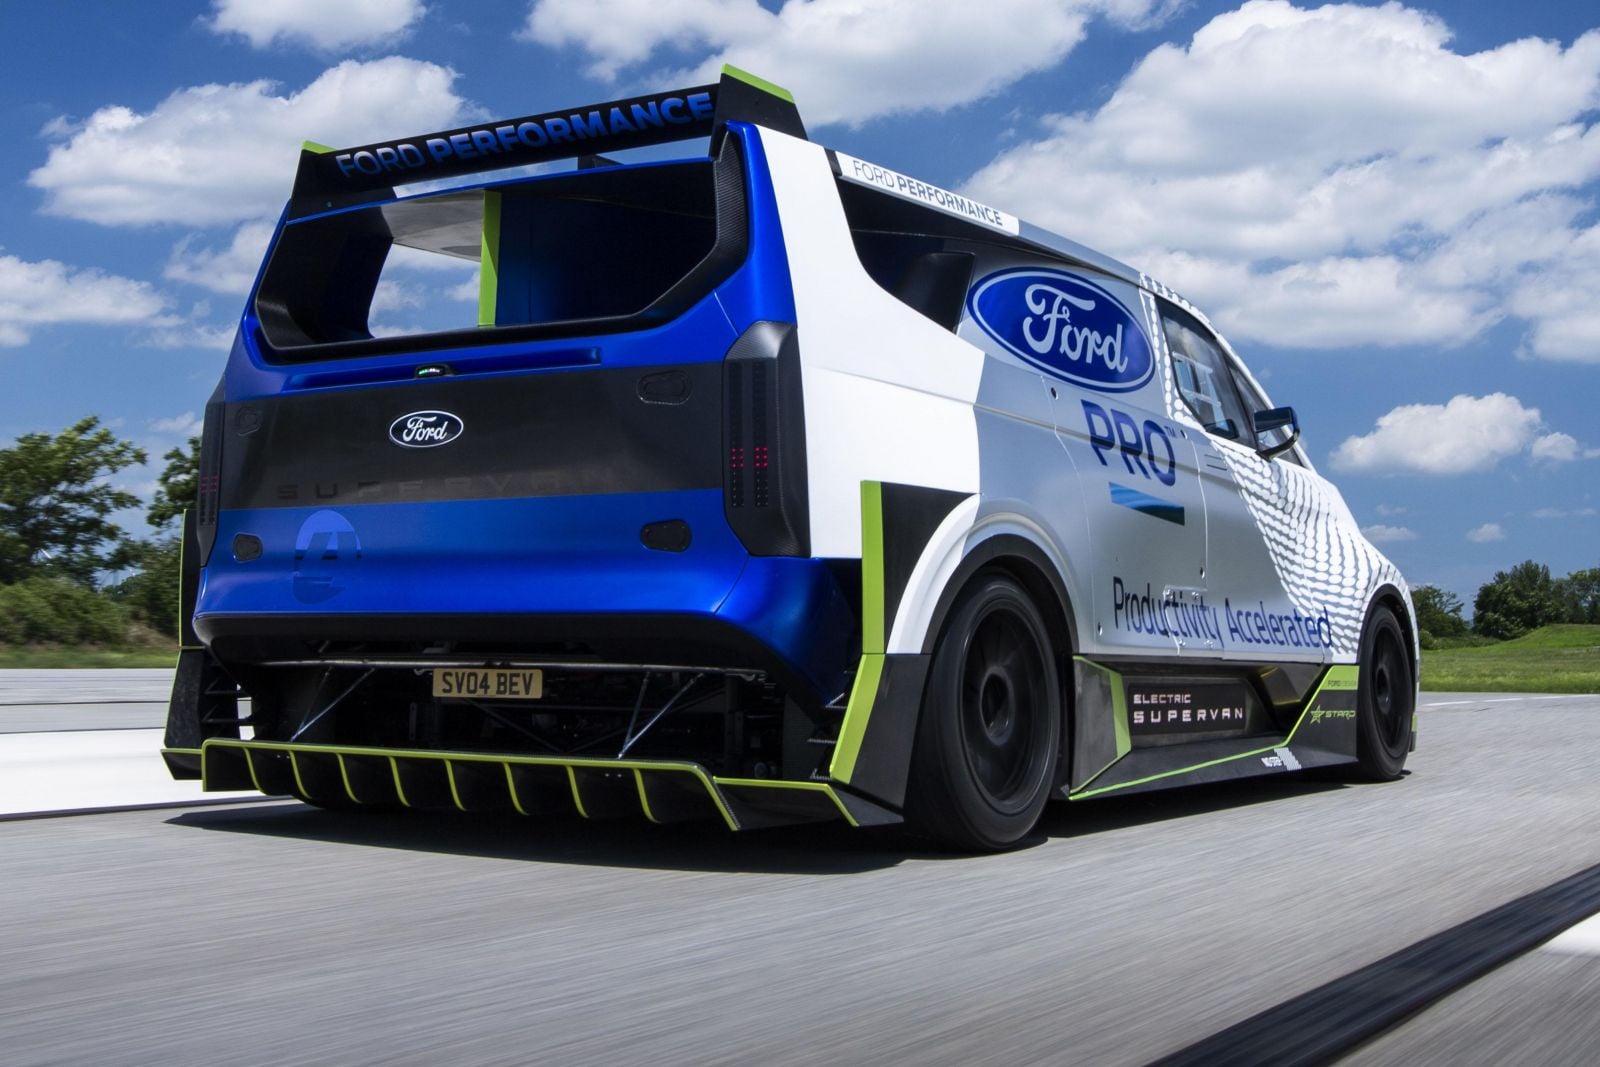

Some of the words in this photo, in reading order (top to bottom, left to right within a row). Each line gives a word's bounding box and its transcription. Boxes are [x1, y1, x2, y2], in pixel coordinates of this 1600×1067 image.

[335, 144, 425, 179] FORD
[426, 92, 714, 163] PERFORMANCE
[854, 160, 895, 188] FORD
[897, 175, 1003, 226] PERFORMANCE
[1022, 283, 1128, 373] Ford
[402, 416, 448, 442] Ford
[1112, 576, 1225, 649] Productivity
[1225, 597, 1333, 649] Accelerated
[496, 672, 534, 696] BEV
[1133, 693, 1192, 704] ELECTRIC
[1133, 706, 1244, 724] SUPERVAN
